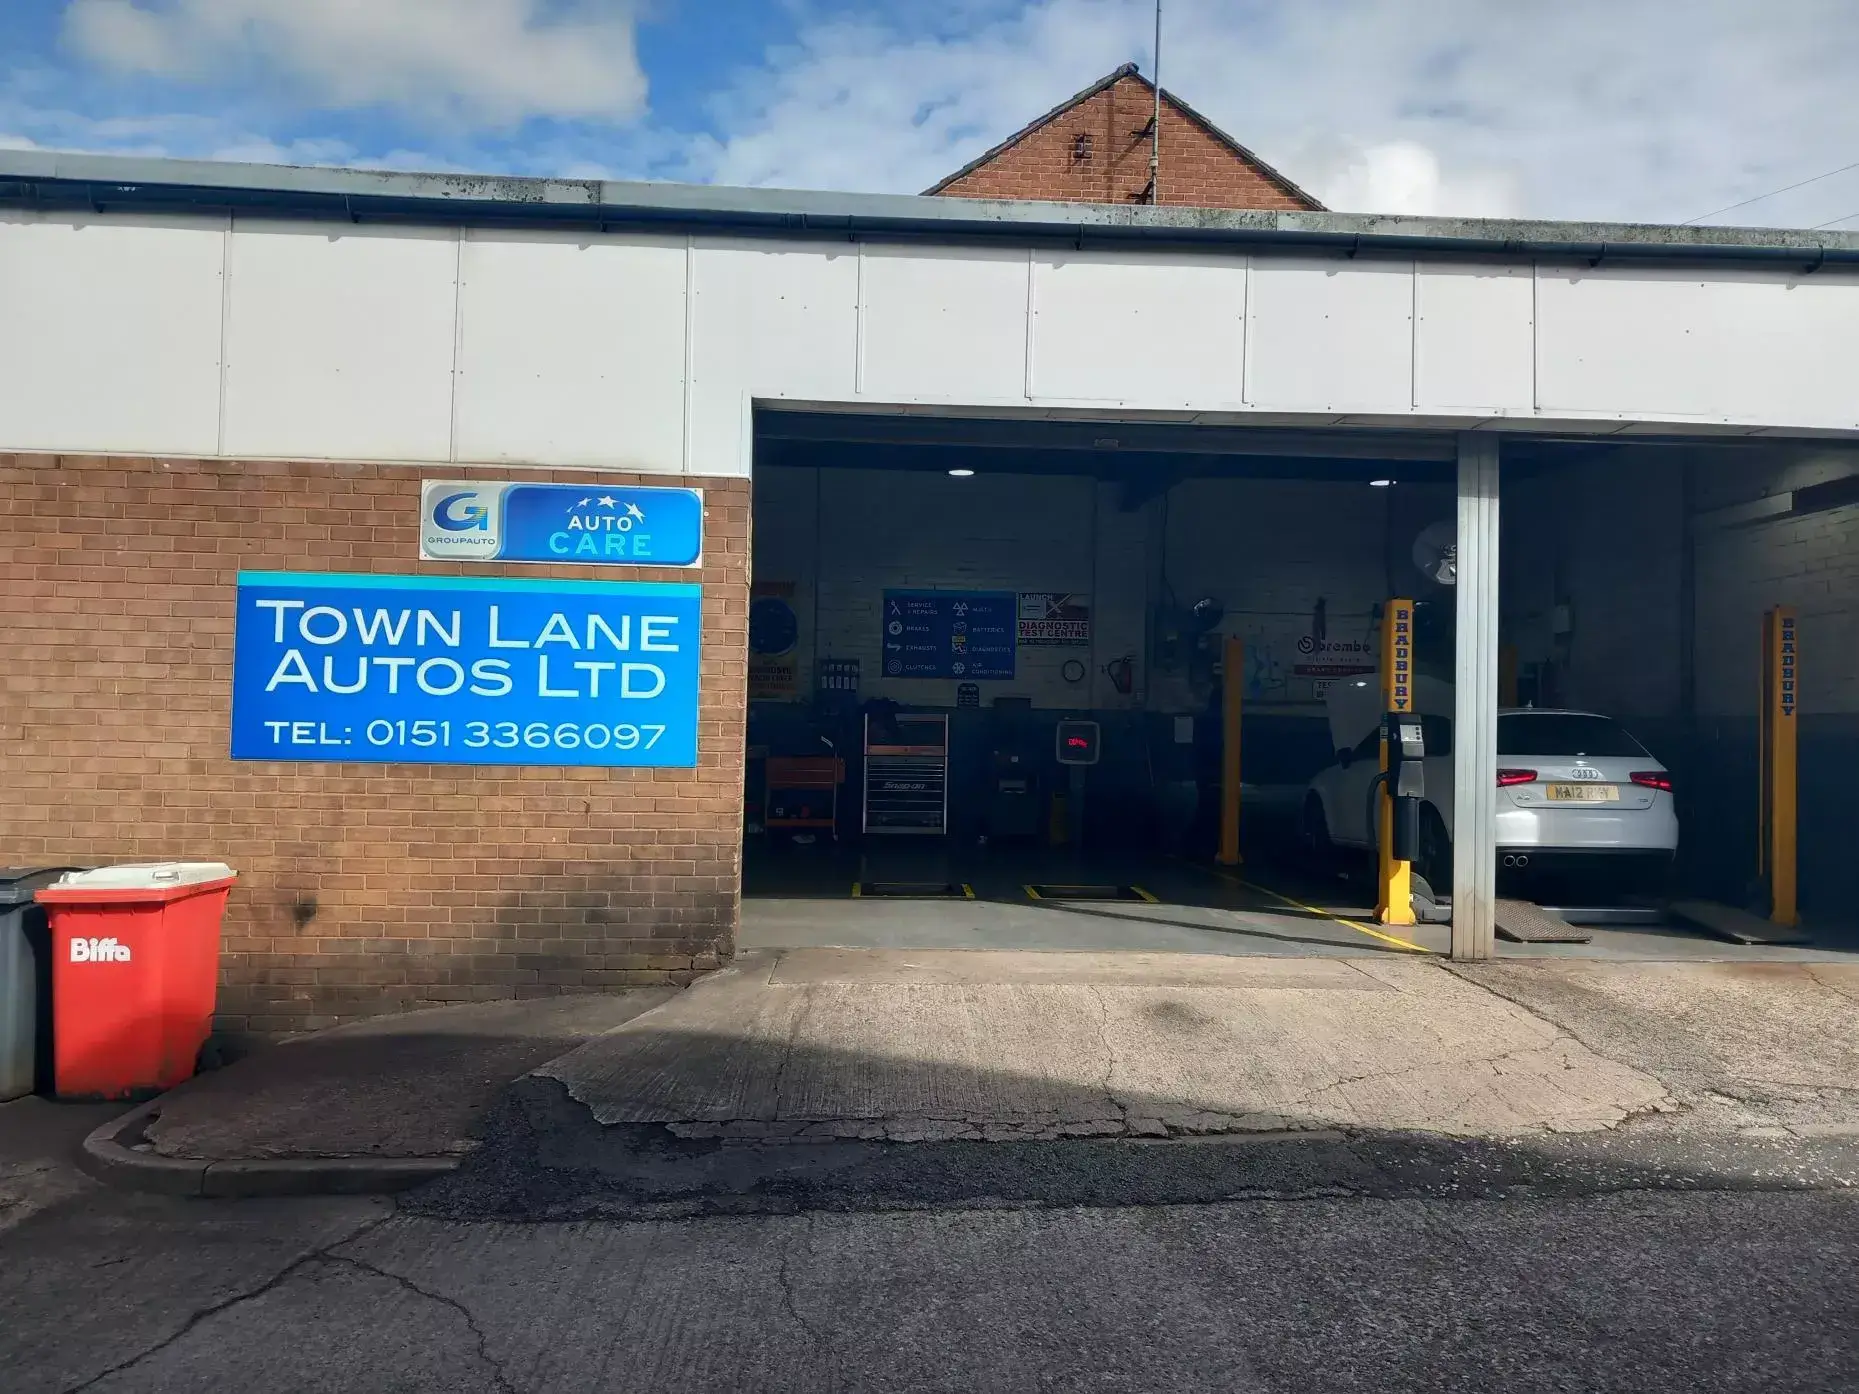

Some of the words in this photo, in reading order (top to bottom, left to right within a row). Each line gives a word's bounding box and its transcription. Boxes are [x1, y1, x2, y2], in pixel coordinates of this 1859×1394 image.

[567, 515, 633, 532] AUTO
[428, 536, 495, 545] GROUPAUTO
[549, 532, 651, 556] CARE
[255, 600, 460, 647] TOWN
[489, 605, 680, 652] LANE
[1019, 621, 1087, 630] DIAGNOSTIC
[1047, 630, 1088, 638] CENTRE
[1393, 609, 1408, 709] BRADBURY
[1782, 618, 1795, 716] BRADBURY
[264, 649, 513, 697] AUTOS
[538, 654, 666, 699] LTD
[264, 721, 352, 745] TEL:
[366, 719, 451, 747] 0151
[463, 722, 667, 750] 3366097
[70, 937, 131, 962] Biffa
